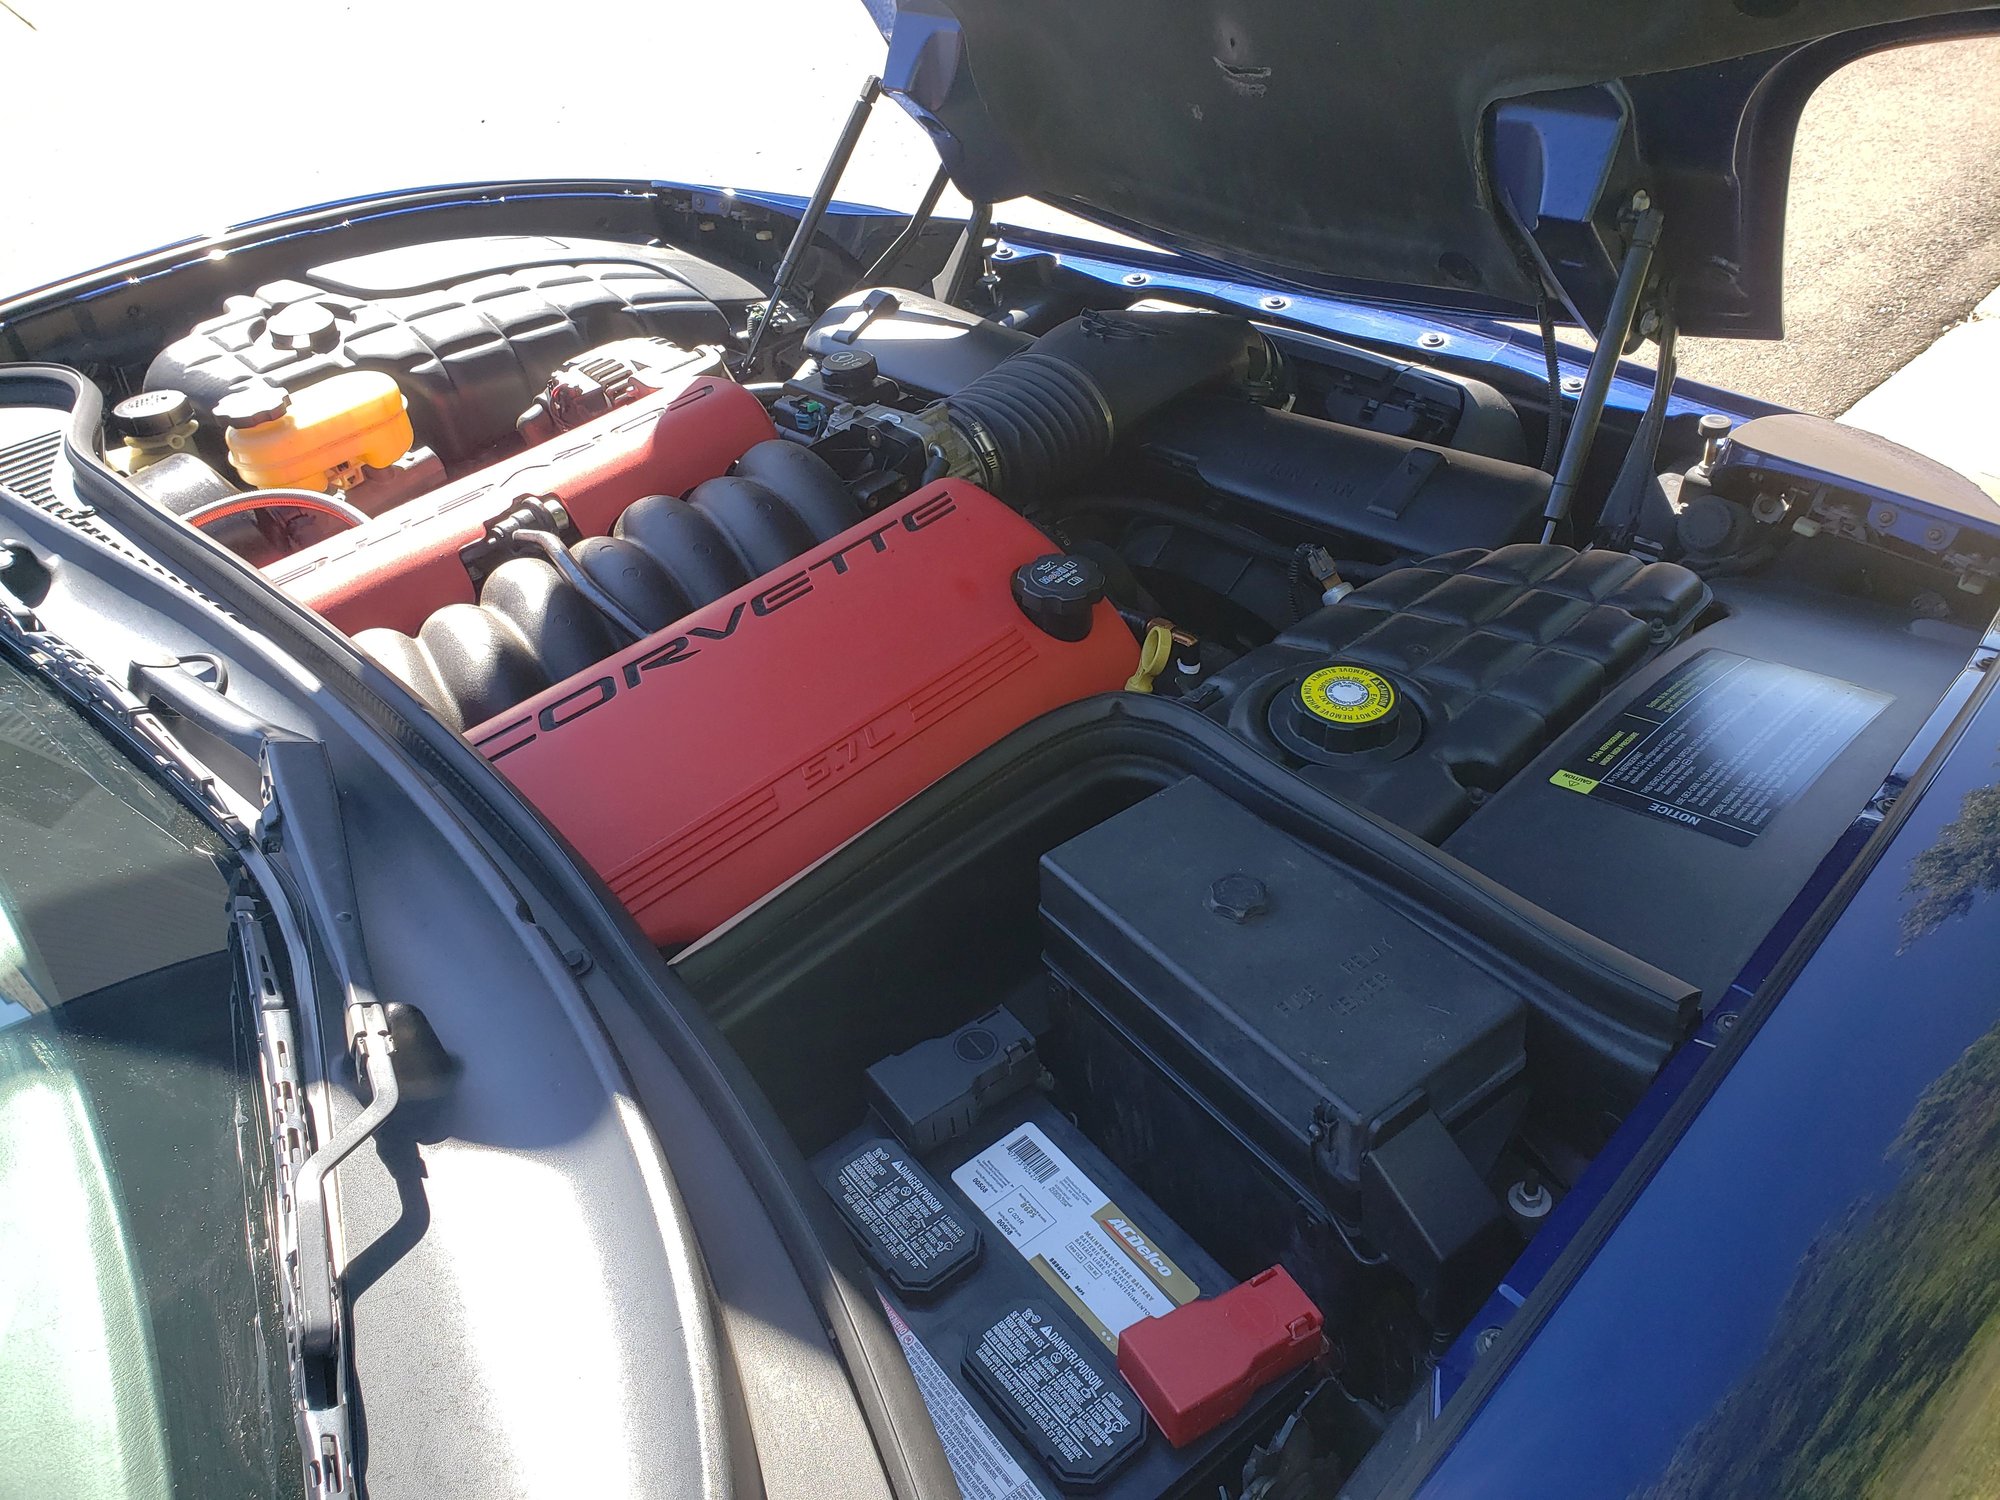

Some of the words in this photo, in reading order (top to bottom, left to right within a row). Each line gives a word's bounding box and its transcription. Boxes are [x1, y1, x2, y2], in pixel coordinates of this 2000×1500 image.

[473, 490, 957, 762] CORVETTE
[1304, 695, 1320, 710] WHEN
[1319, 695, 1354, 711] COOLANT
[1358, 693, 1377, 711] ENGINE
[1320, 708, 1353, 721] REMOVE
[1356, 713, 1372, 721] NOT
[801, 726, 896, 790] 5.7L
[1563, 773, 1593, 786] CAUTION
[1647, 801, 1701, 827] NOTICE
[849, 1159, 865, 1174] GASES
[856, 1155, 879, 1177] EXPLOSIVE
[862, 1150, 879, 1166] SHIELD
[873, 1163, 888, 1176] EYES
[837, 1174, 849, 1187] KEEP
[844, 1184, 856, 1195] OUT
[897, 1165, 944, 1213] DANGER/POISON
[852, 1192, 861, 1200] OF
[856, 1197, 867, 1208] THE
[862, 1205, 878, 1220] REACH
[904, 1201, 917, 1213] ACID
[842, 1192, 855, 1204] KEEP
[851, 1202, 863, 1215] VENT
[859, 1212, 872, 1225] CAPS
[867, 1222, 881, 1236] TIGHT
[877, 1234, 889, 1245] AND
[873, 1217, 882, 1226] OF
[895, 1243, 905, 1253] DO
[1105, 1212, 1175, 1279] ACDelco
[901, 1249, 913, 1261] NOT
[1078, 1234, 1100, 1256] BATTERIE
[1098, 1255, 1112, 1268] SANS
[1110, 1267, 1136, 1293] ENTRETIEN
[1083, 1230, 1120, 1266] MAINTENANCE
[1117, 1265, 1132, 1279] FREE
[1130, 1278, 1154, 1302] BATTERY
[1091, 1256, 1106, 1270] LIBRE
[1104, 1269, 1113, 1277] DE
[1110, 1275, 1151, 1316] MANTENIMIENTO
[1002, 1315, 1018, 1330] YEUX
[1012, 1326, 1024, 1337] LES
[1018, 1332, 1030, 1343] GAZ
[1009, 1310, 1020, 1319] SE
[1032, 1336, 1045, 1348] LES
[1038, 1354, 1060, 1376] AUCUNE
[1046, 1331, 1104, 1390] DANGER/POISON
[1051, 1380, 1063, 1393] PEUT
[1064, 1369, 1084, 1390] L'ACIDE
[989, 1353, 1003, 1367] HORS
[999, 1364, 1009, 1374] DE
[1004, 1370, 1014, 1379] LA
[1022, 1391, 1035, 1403] DES
[1047, 1419, 1058, 1429] NE
[1053, 1425, 1065, 1438] PAS
[1045, 1385, 1053, 1393] LA
[1057, 1375, 1086, 1405] SULFURIQUE
[988, 1363, 998, 1372] LE
[1024, 1405, 1038, 1418] BIEN
[1045, 1429, 1055, 1439] ET
[1051, 1435, 1061, 1445] DE
[1094, 1402, 1105, 1412] LES
[1081, 1412, 1090, 1421] ET
